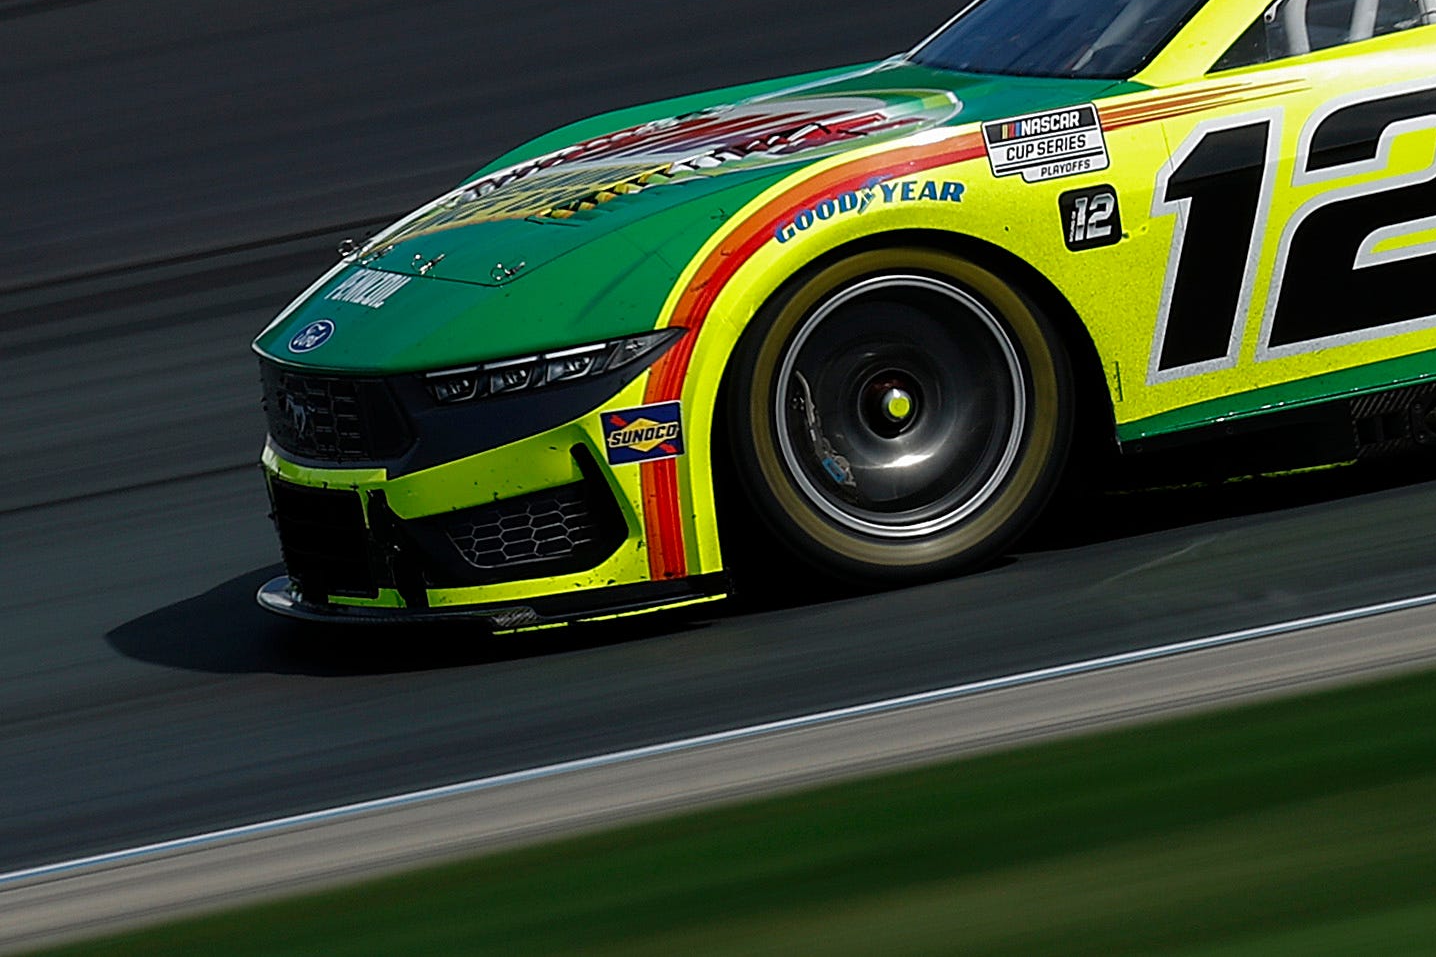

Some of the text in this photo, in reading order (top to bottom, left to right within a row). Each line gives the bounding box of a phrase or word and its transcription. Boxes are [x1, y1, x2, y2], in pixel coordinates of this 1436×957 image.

[1020, 111, 1081, 137] NASCAR
[1006, 133, 1087, 161] CUP SERIES
[1040, 158, 1091, 178] PLAYOFFS
[1074, 193, 1115, 241] 12
[608, 422, 681, 448] SUNOCO
